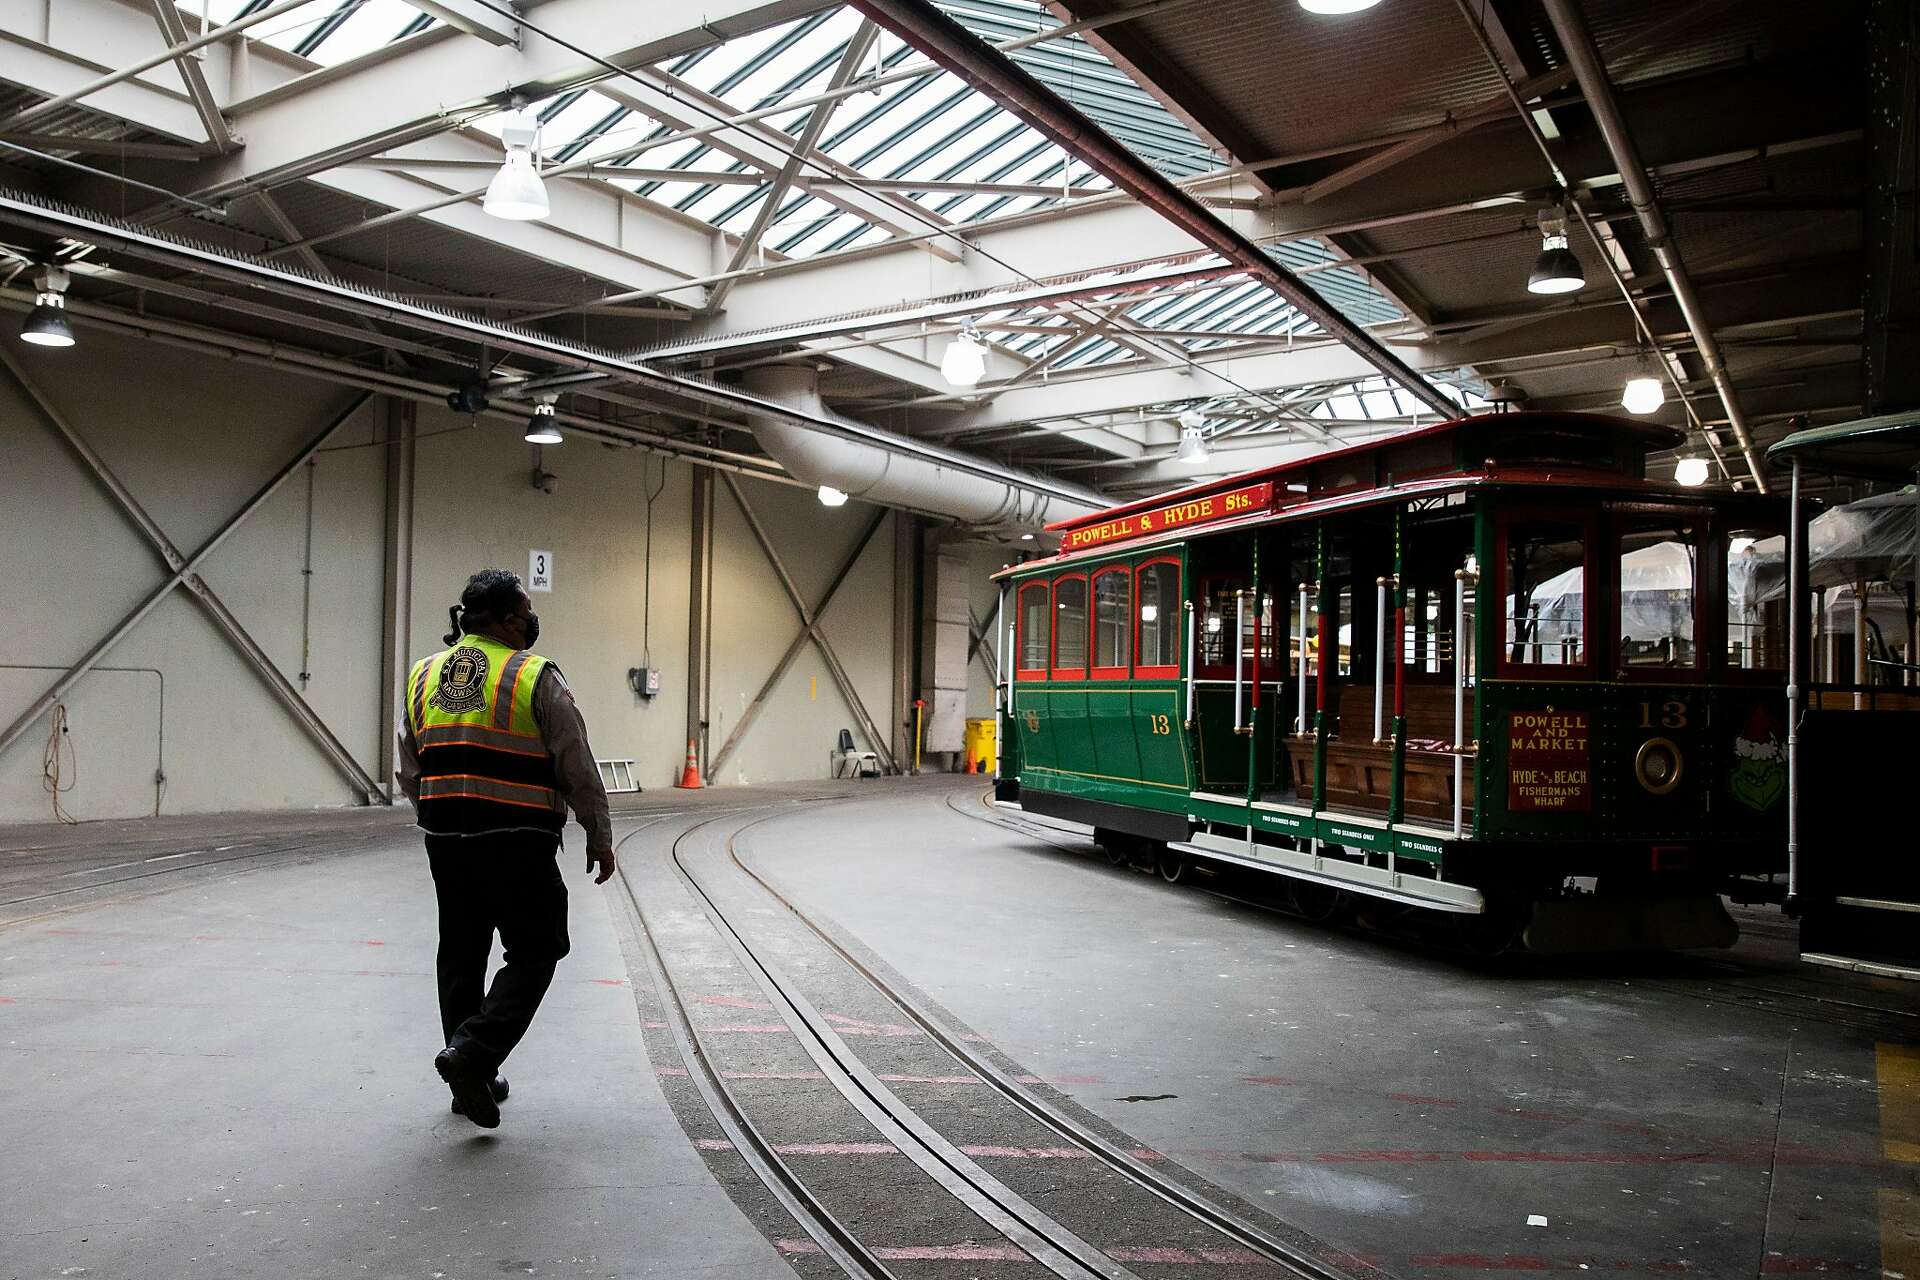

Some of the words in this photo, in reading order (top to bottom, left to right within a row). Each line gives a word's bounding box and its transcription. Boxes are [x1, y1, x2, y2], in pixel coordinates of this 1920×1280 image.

[1072, 521, 1132, 546] POWELL
[1140, 516, 1153, 530] &
[1164, 500, 1213, 524] HYDE
[1225, 492, 1252, 511] Sts.
[537, 555, 545, 575] 3
[533, 576, 548, 587] MPH
[453, 649, 487, 677] MUNICIPAL
[442, 681, 477, 697] RAILWAY
[1637, 701, 1688, 729] 13
[1151, 714, 1170, 735] 13
[1513, 716, 1586, 728] POWELL
[1532, 728, 1568, 738] AND
[1511, 738, 1587, 750] MARKET
[1512, 770, 1539, 784] HYDE
[1554, 770, 1587, 784] BEACH
[1519, 786, 1581, 796] FISHERMANS
[1534, 797, 1567, 807] WHARF
[1331, 828, 1341, 836] TWO
[1362, 833, 1375, 841] ONLY
[1401, 840, 1413, 849] TWO
